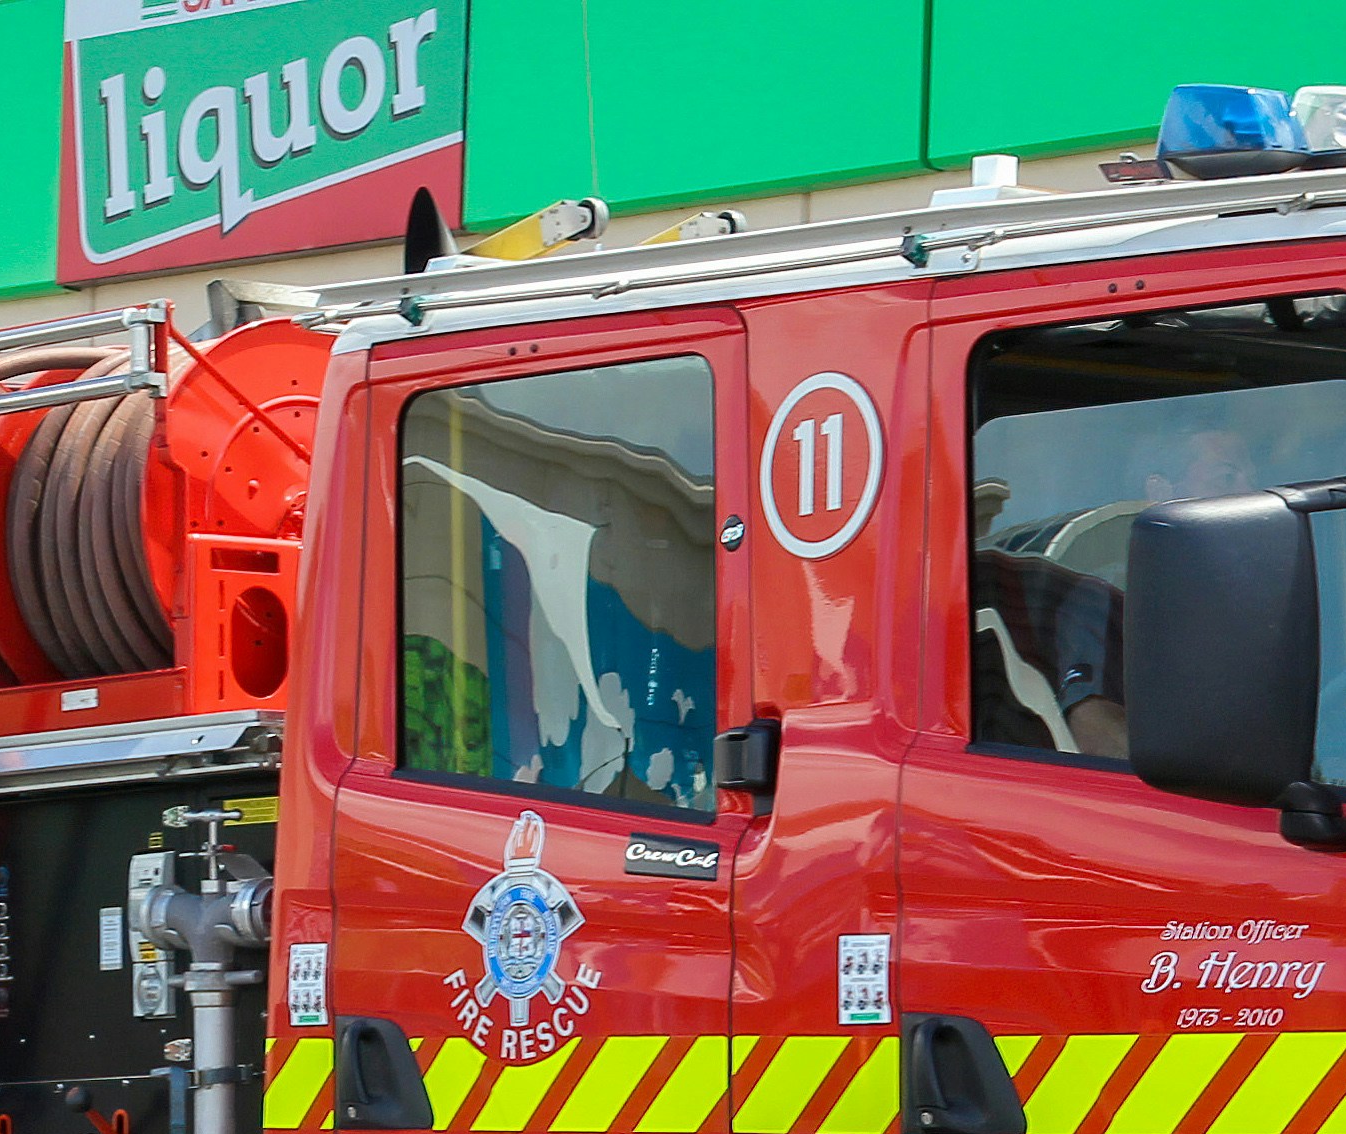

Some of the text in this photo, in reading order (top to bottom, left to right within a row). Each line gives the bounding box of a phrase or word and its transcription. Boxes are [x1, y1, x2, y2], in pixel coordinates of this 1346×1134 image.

[100, 9, 437, 235] liquor
[792, 413, 843, 516] 11
[1160, 919, 1310, 944] Station Officer
[1140, 950, 1326, 999] B. Henry
[443, 963, 602, 1060] FIRE RESCUE
[1234, 1007, 1284, 1027] 2010
